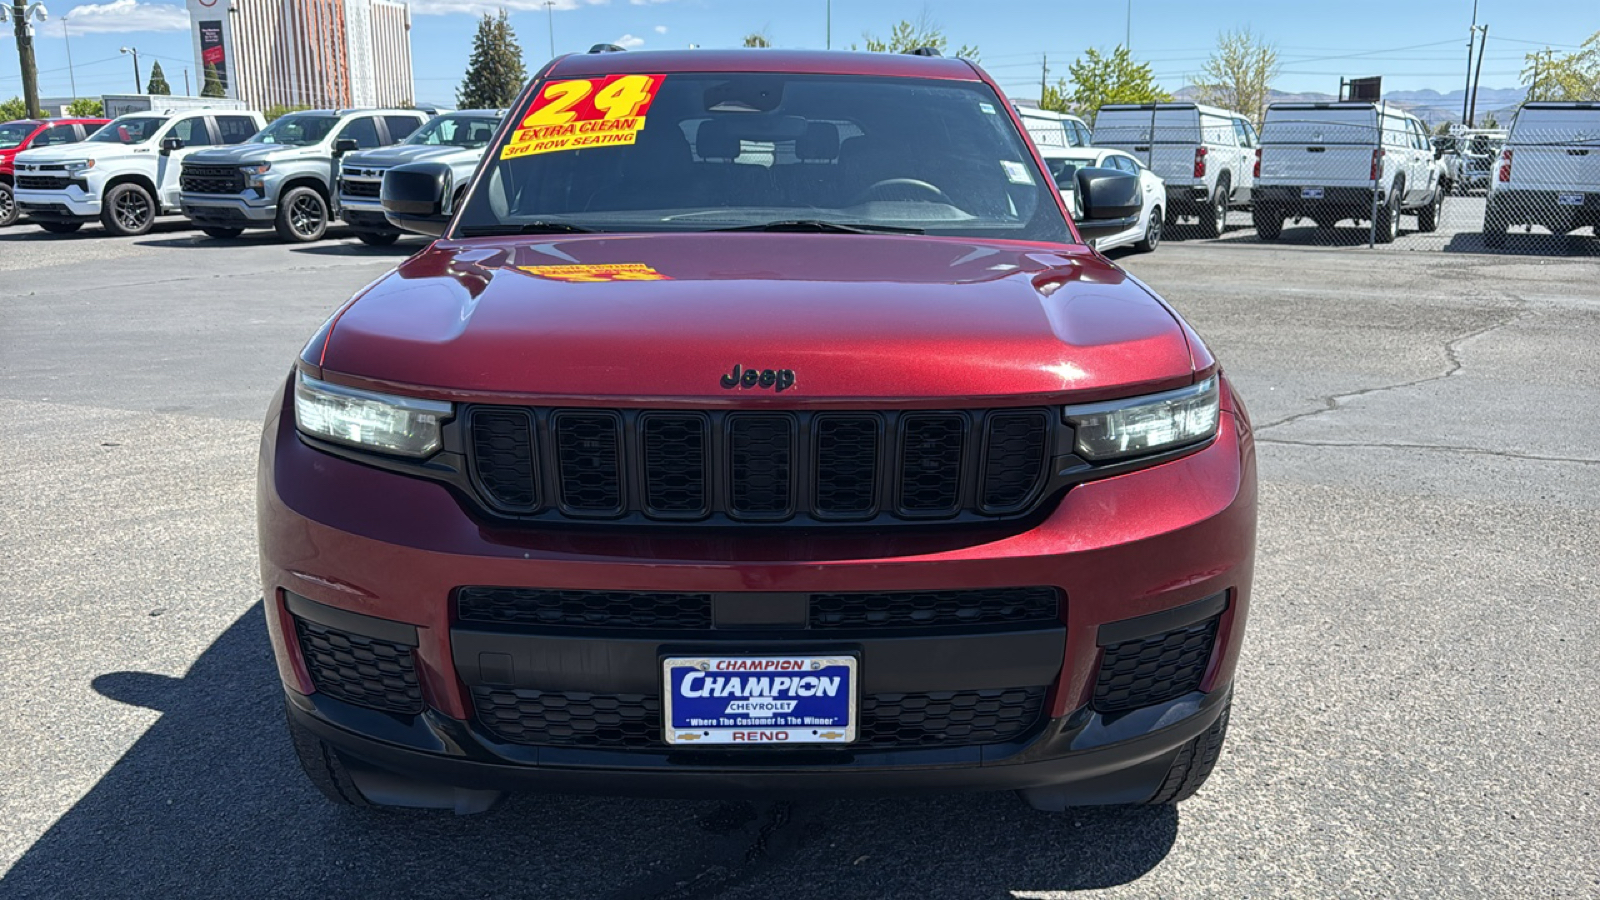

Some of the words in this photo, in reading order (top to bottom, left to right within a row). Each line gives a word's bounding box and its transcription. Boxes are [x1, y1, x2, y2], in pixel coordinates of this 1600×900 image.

[523, 75, 654, 127] 24
[519, 123, 577, 141] EXTRA
[578, 118, 637, 133] CLEAN
[505, 144, 530, 156] 3rd
[533, 139, 569, 150] ROW
[571, 133, 634, 146] SEATING
[720, 364, 796, 392] Jeep
[716, 660, 804, 671] CHAMPION
[730, 702, 792, 711] CHEVROLET
[719, 717, 735, 726] The
[736, 717, 776, 726] Customer
[777, 717, 786, 726] Is
[787, 716, 802, 725] The
[732, 731, 789, 741] RENO
